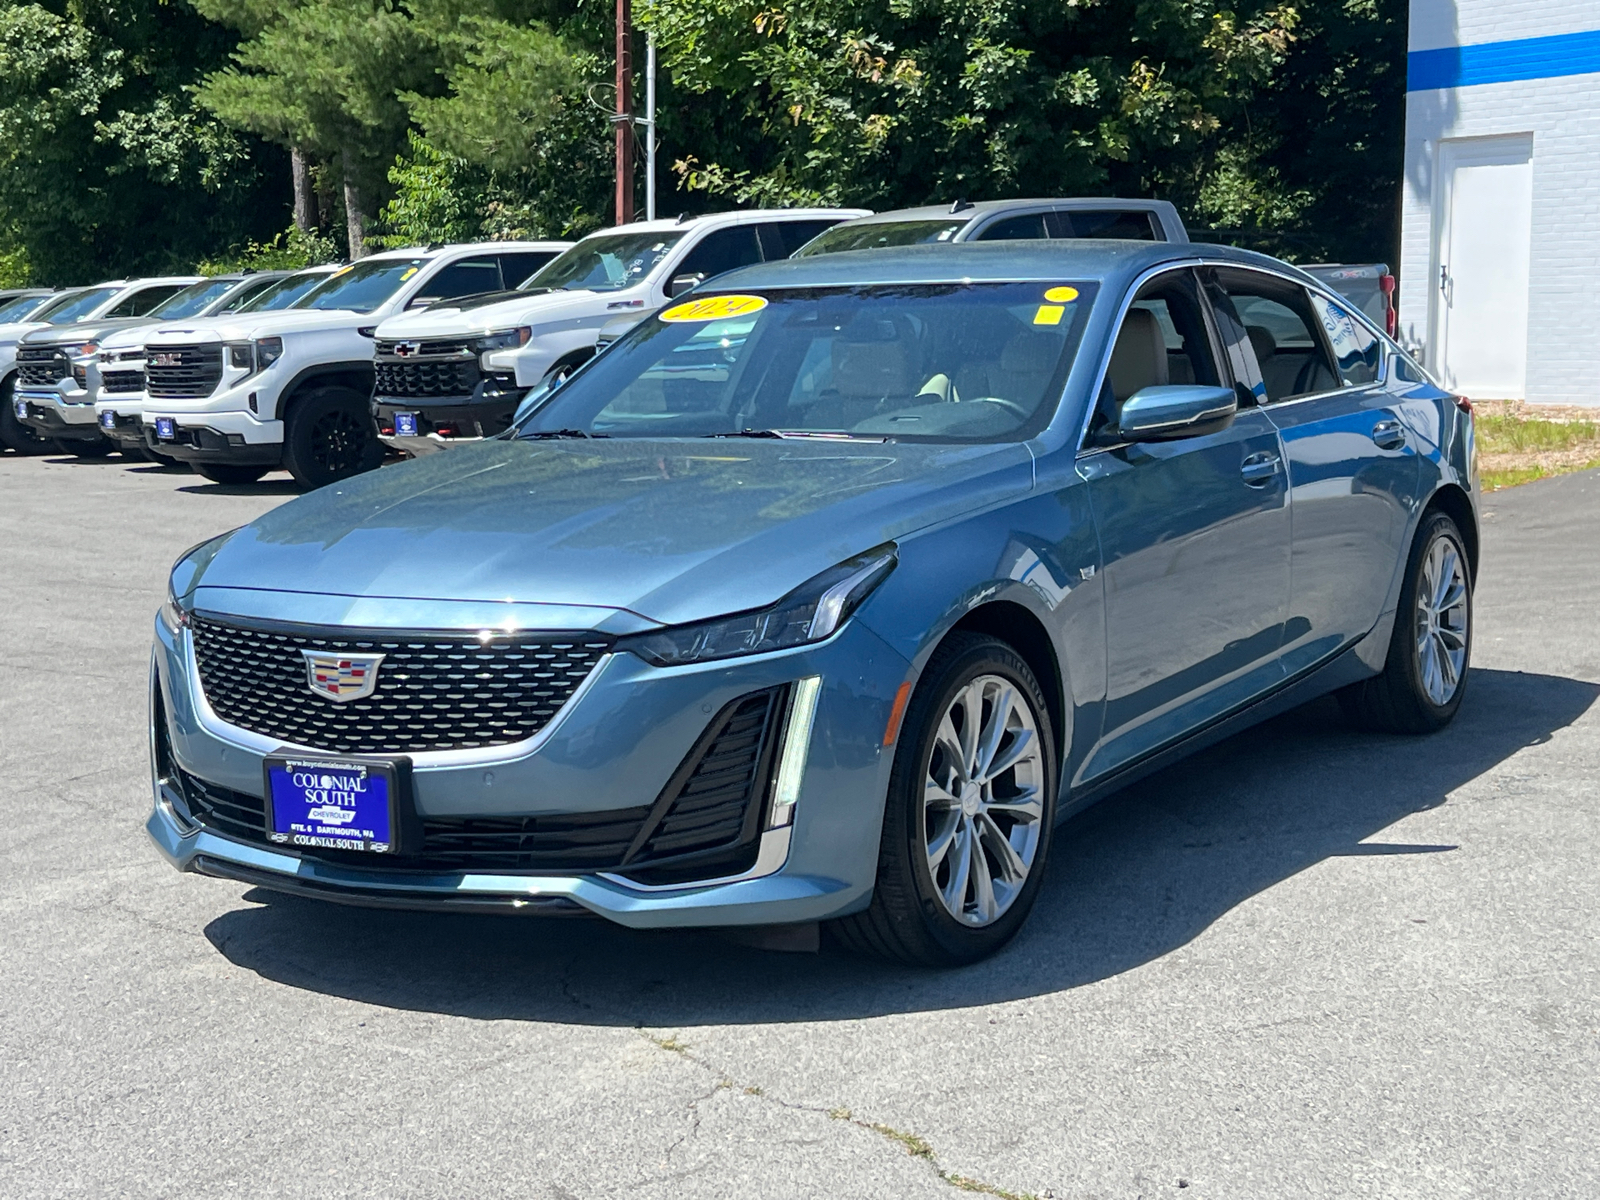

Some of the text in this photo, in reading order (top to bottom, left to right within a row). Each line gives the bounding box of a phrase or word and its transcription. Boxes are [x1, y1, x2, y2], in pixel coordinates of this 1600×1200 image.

[293, 772, 367, 793] COLONIAL
[304, 788, 356, 806] SOUTH
[312, 810, 351, 819] CHEVROLET
[294, 835, 364, 850] COLONIAL SOUTH
